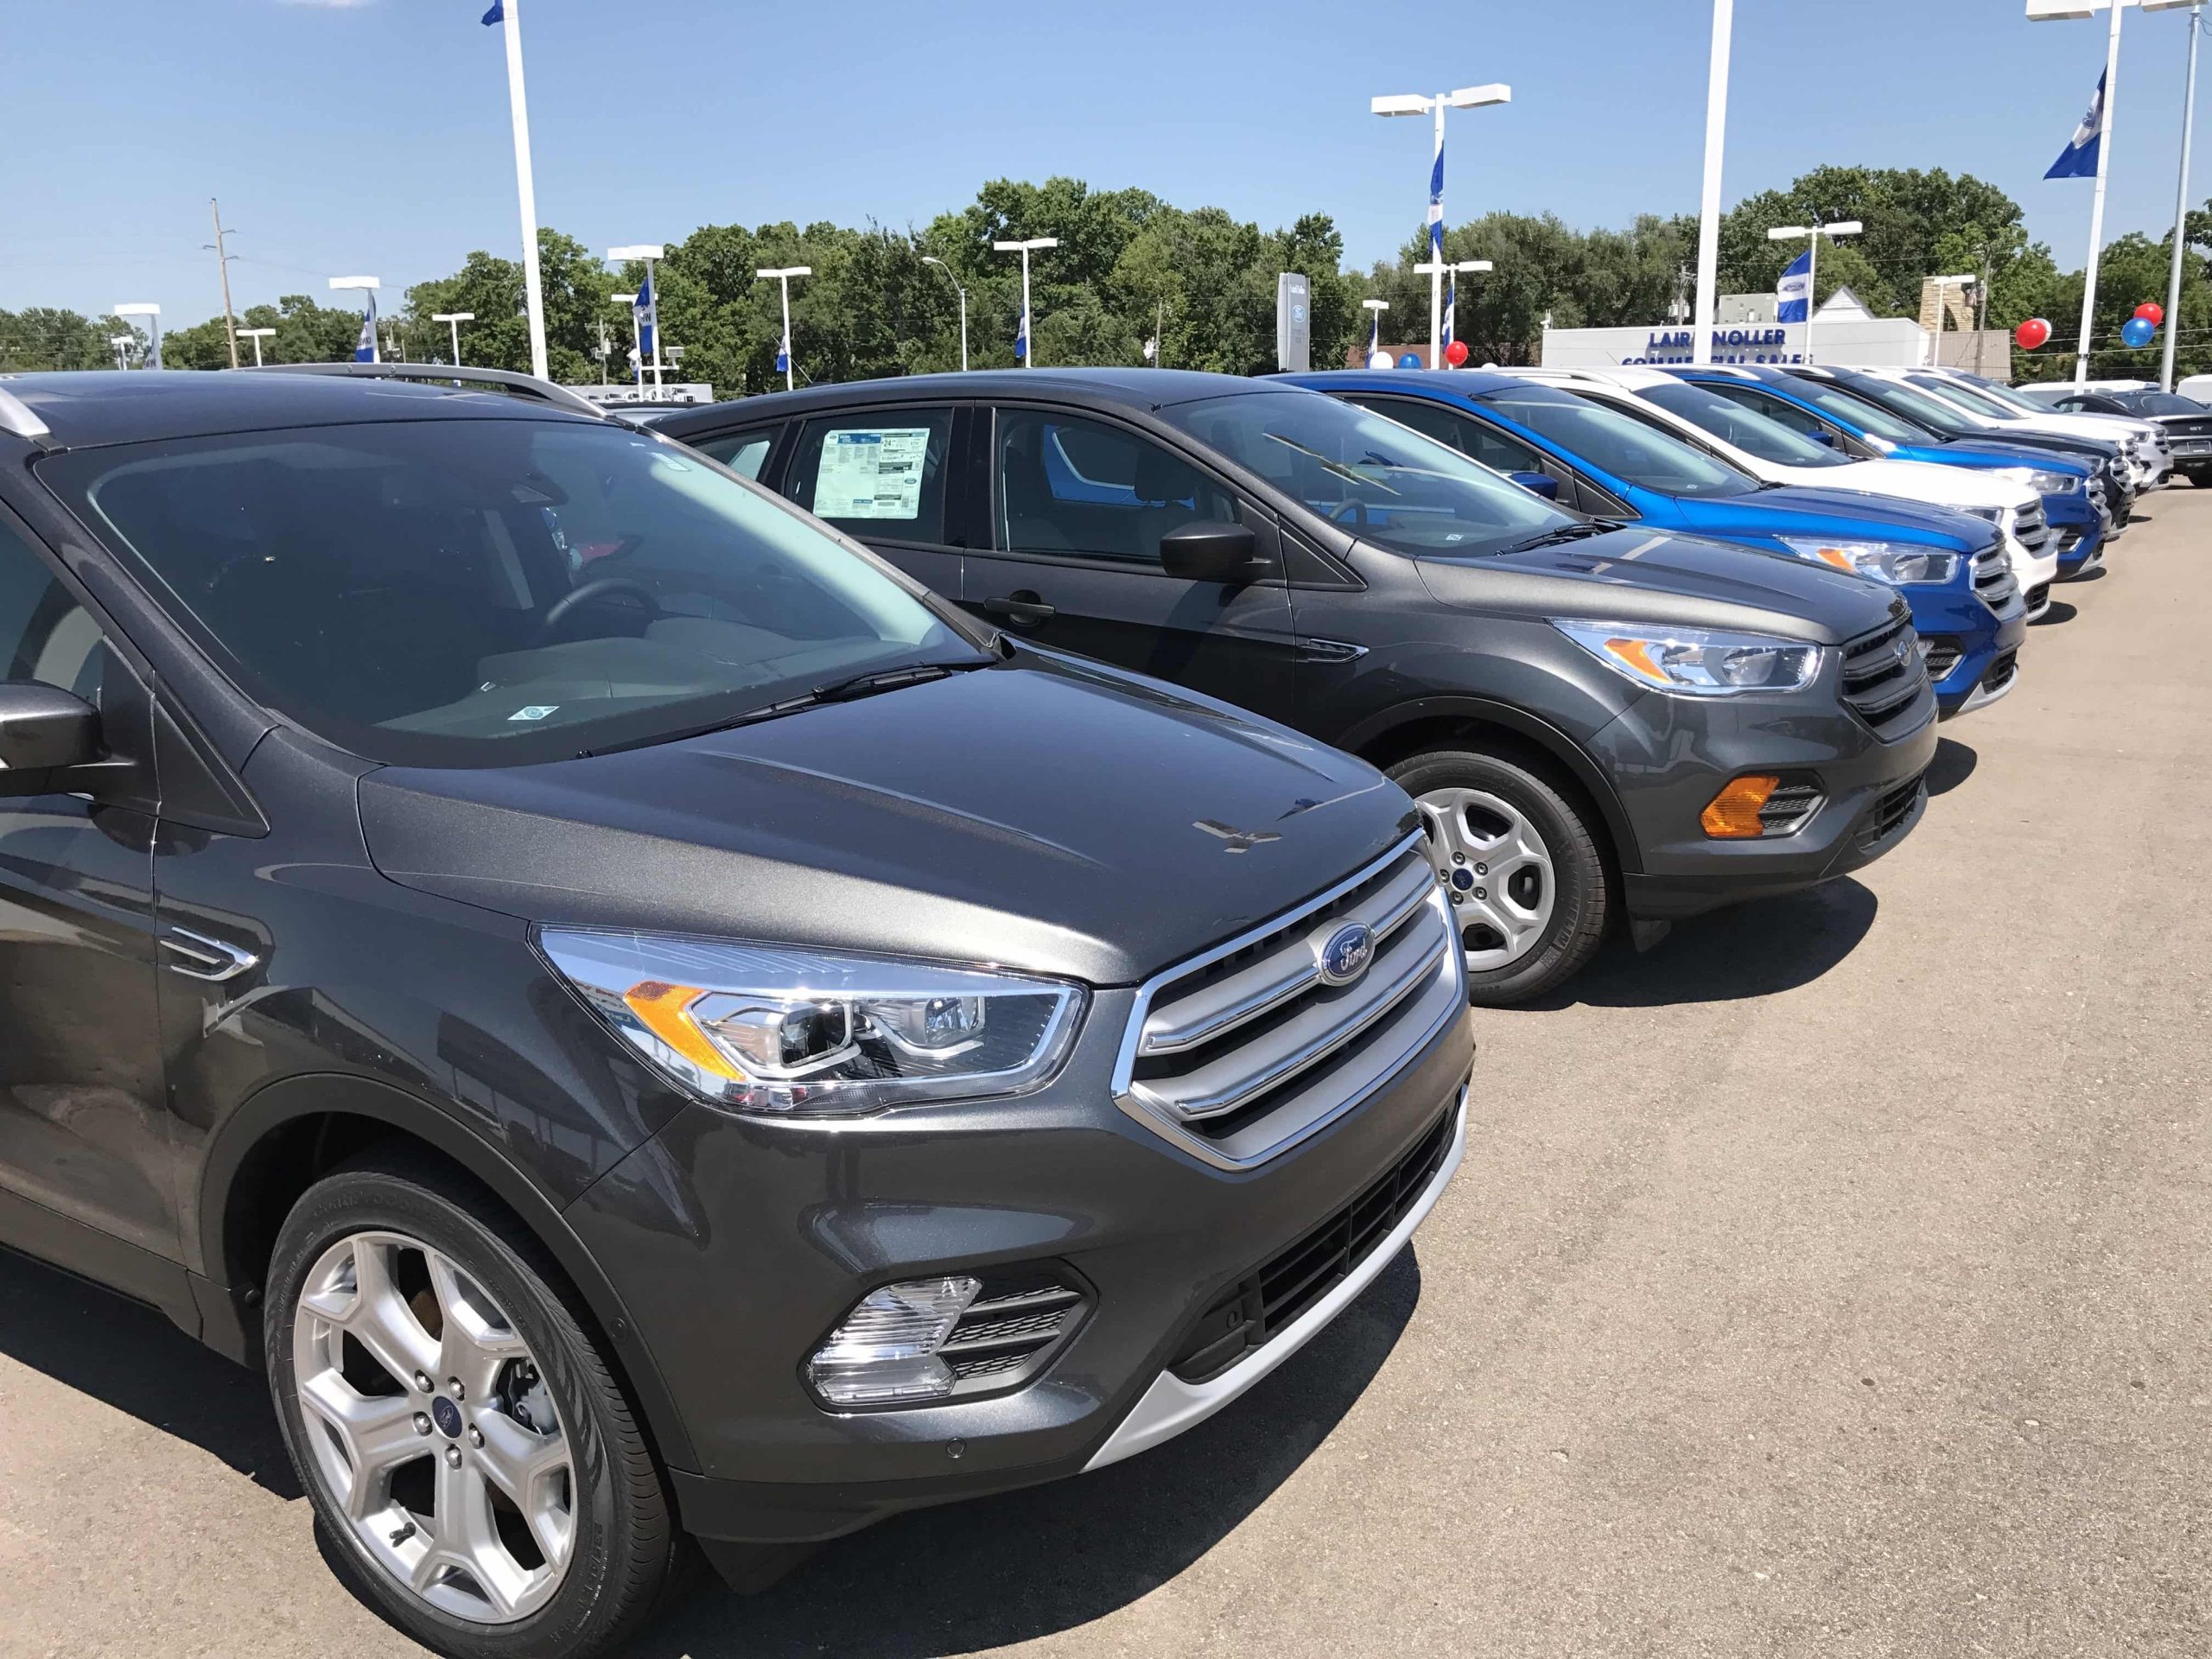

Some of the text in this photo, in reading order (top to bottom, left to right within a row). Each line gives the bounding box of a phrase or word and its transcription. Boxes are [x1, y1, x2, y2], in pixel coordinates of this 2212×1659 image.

[1649, 329, 1786, 347] LAIR NOLLER
[1339, 935, 1368, 971] Ford
